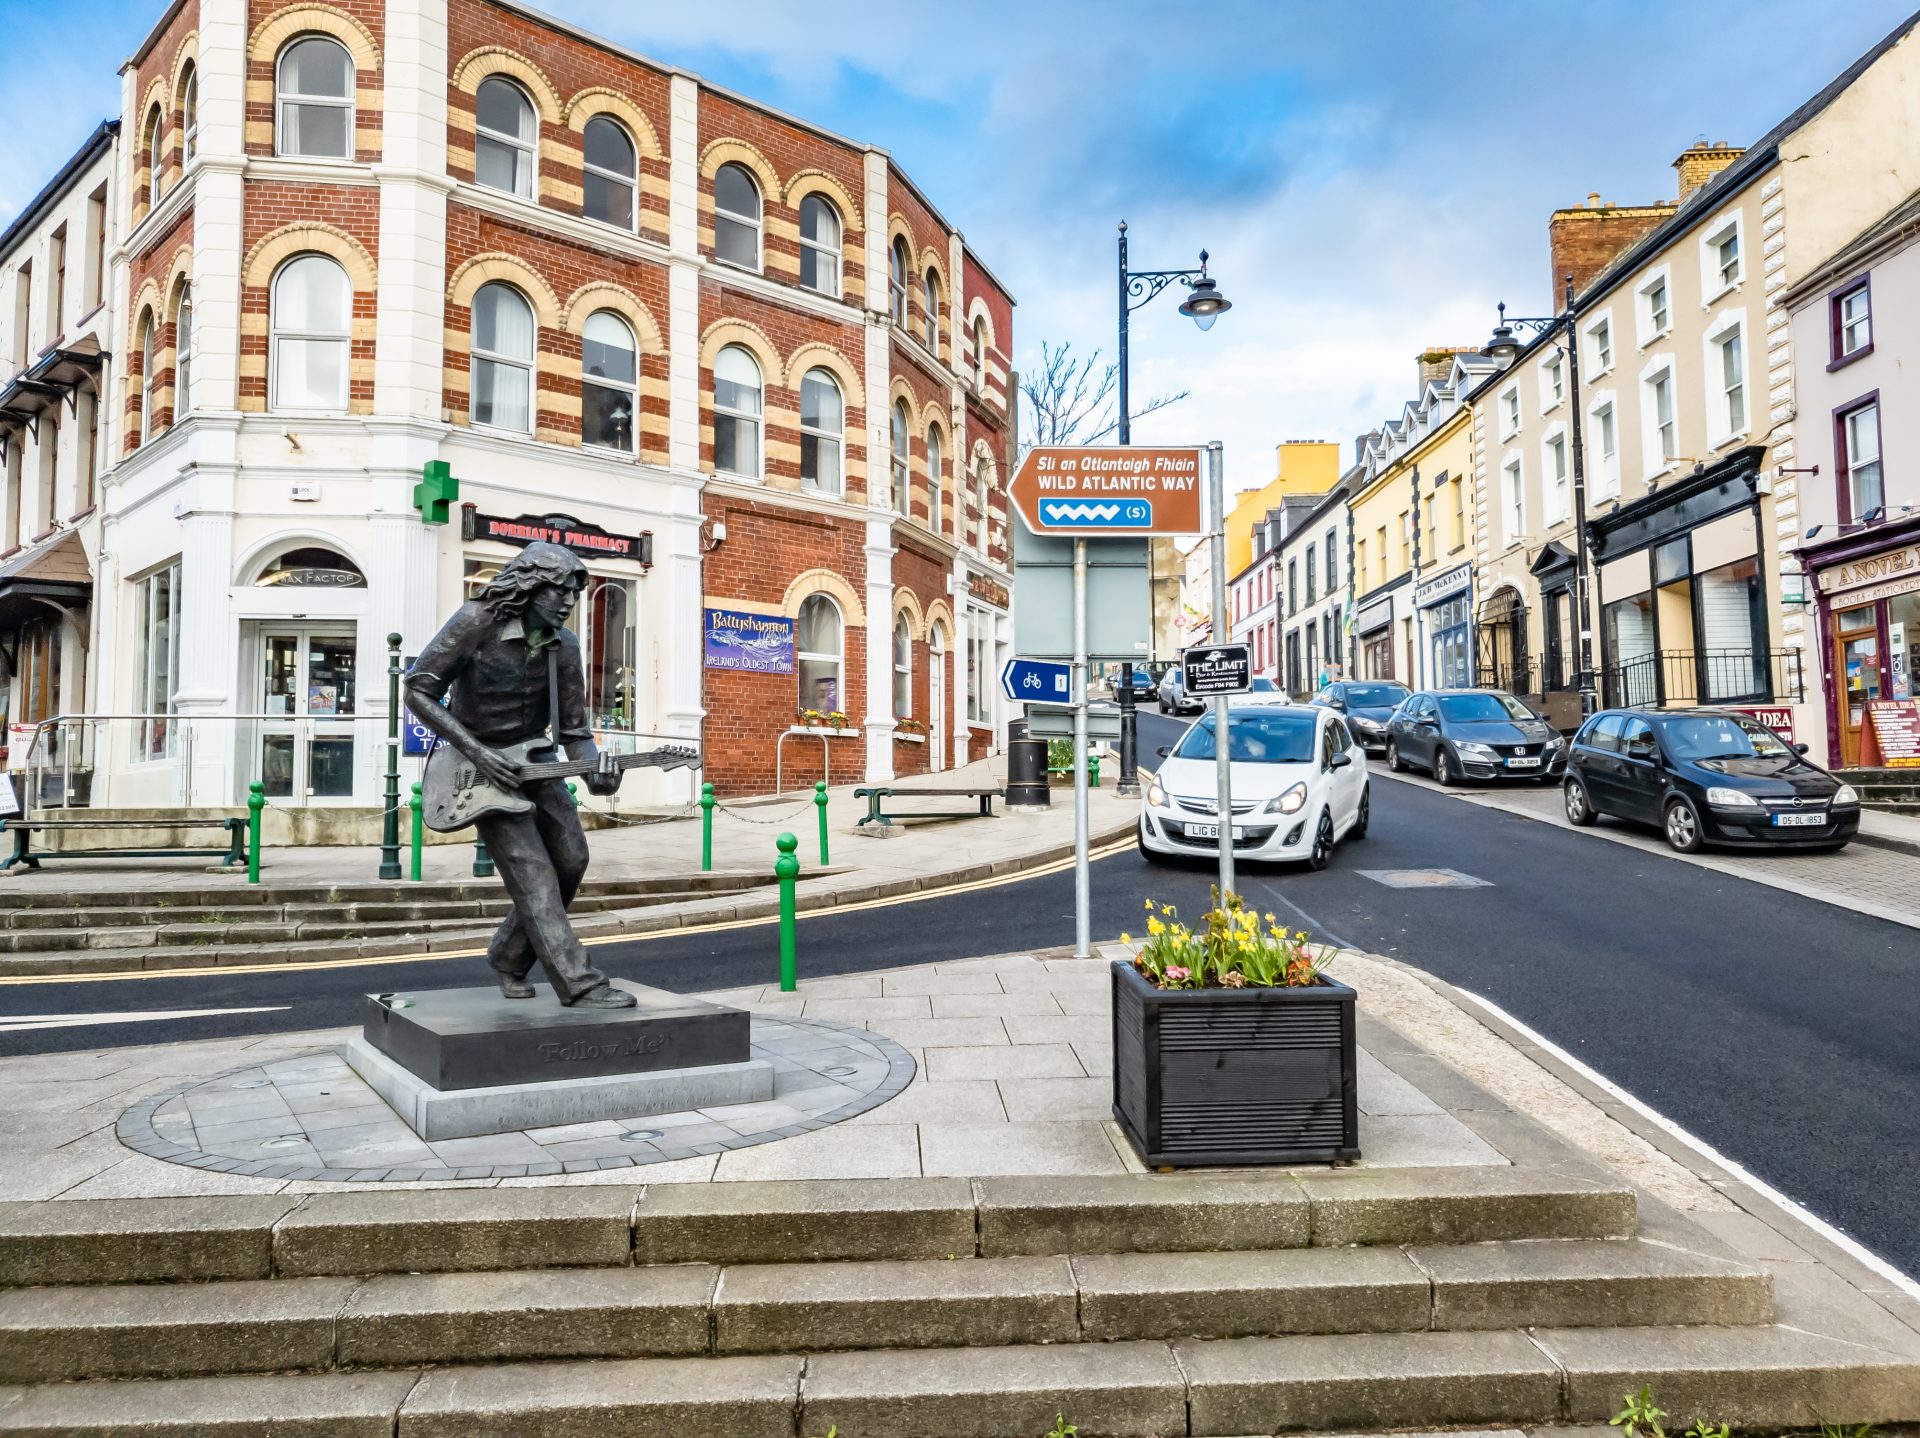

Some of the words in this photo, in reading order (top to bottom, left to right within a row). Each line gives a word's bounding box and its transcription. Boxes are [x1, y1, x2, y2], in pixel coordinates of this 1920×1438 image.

[1061, 461, 1076, 470] an
[1081, 457, 1150, 473] Atlantaigh
[1155, 457, 1195, 471] Fhiáin
[1038, 476, 1076, 490] WILD
[1082, 476, 1156, 490] ATLANTIC
[1162, 476, 1195, 490] WAY
[1126, 506, 1146, 519] (S)
[564, 532, 630, 553] PHARMACY
[1839, 568, 1853, 586] A
[1853, 551, 1913, 582] NOVEL
[306, 571, 354, 583] FACTOR
[1838, 593, 1865, 607] BOOKS
[1872, 580, 1920, 598] STATIONERY
[712, 611, 789, 634] Ballyshannon
[706, 654, 739, 667] IRELAND'S
[742, 657, 769, 670] OLDEST
[773, 660, 792, 672] TOWN
[1187, 662, 1214, 673] THE
[1215, 660, 1246, 671] LIMIT
[1877, 702, 1898, 710] NOVEL
[1899, 701, 1915, 709] IDEA
[1755, 711, 1791, 727] IDEA
[1782, 816, 1822, 825] 05-DL-1853
[1193, 826, 1207, 836] LIG
